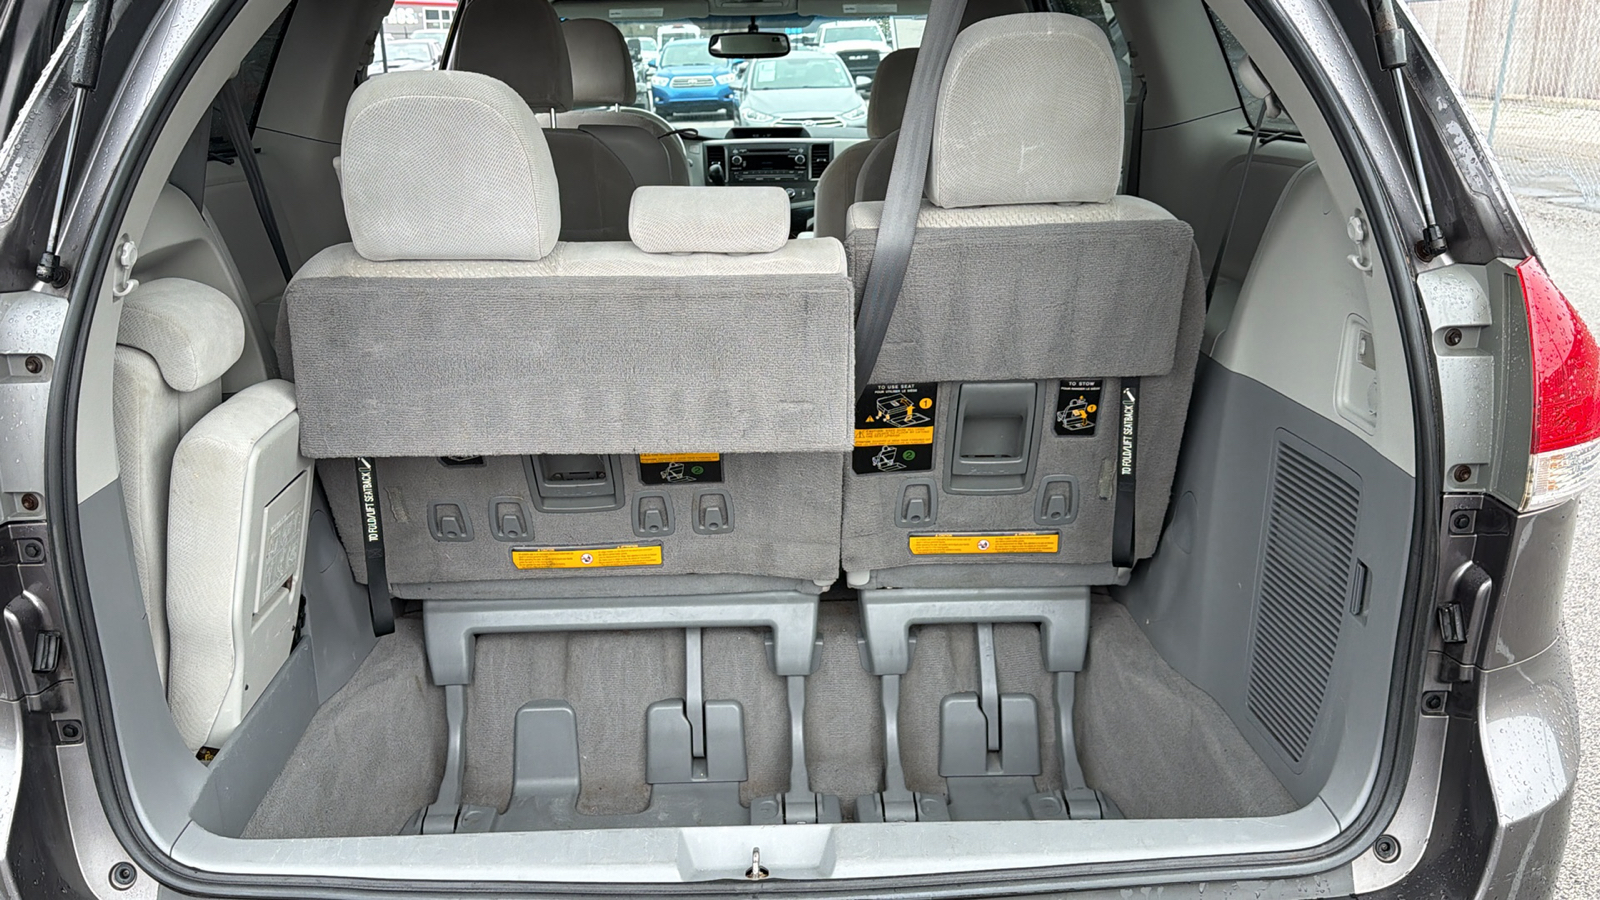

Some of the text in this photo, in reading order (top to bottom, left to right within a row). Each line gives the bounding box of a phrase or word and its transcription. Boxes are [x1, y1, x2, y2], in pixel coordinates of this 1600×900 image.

[1122, 405, 1133, 475] TO FOLD/LIFT SEATBACK
[361, 472, 374, 502] SEATBACK
[368, 533, 379, 542] TO
